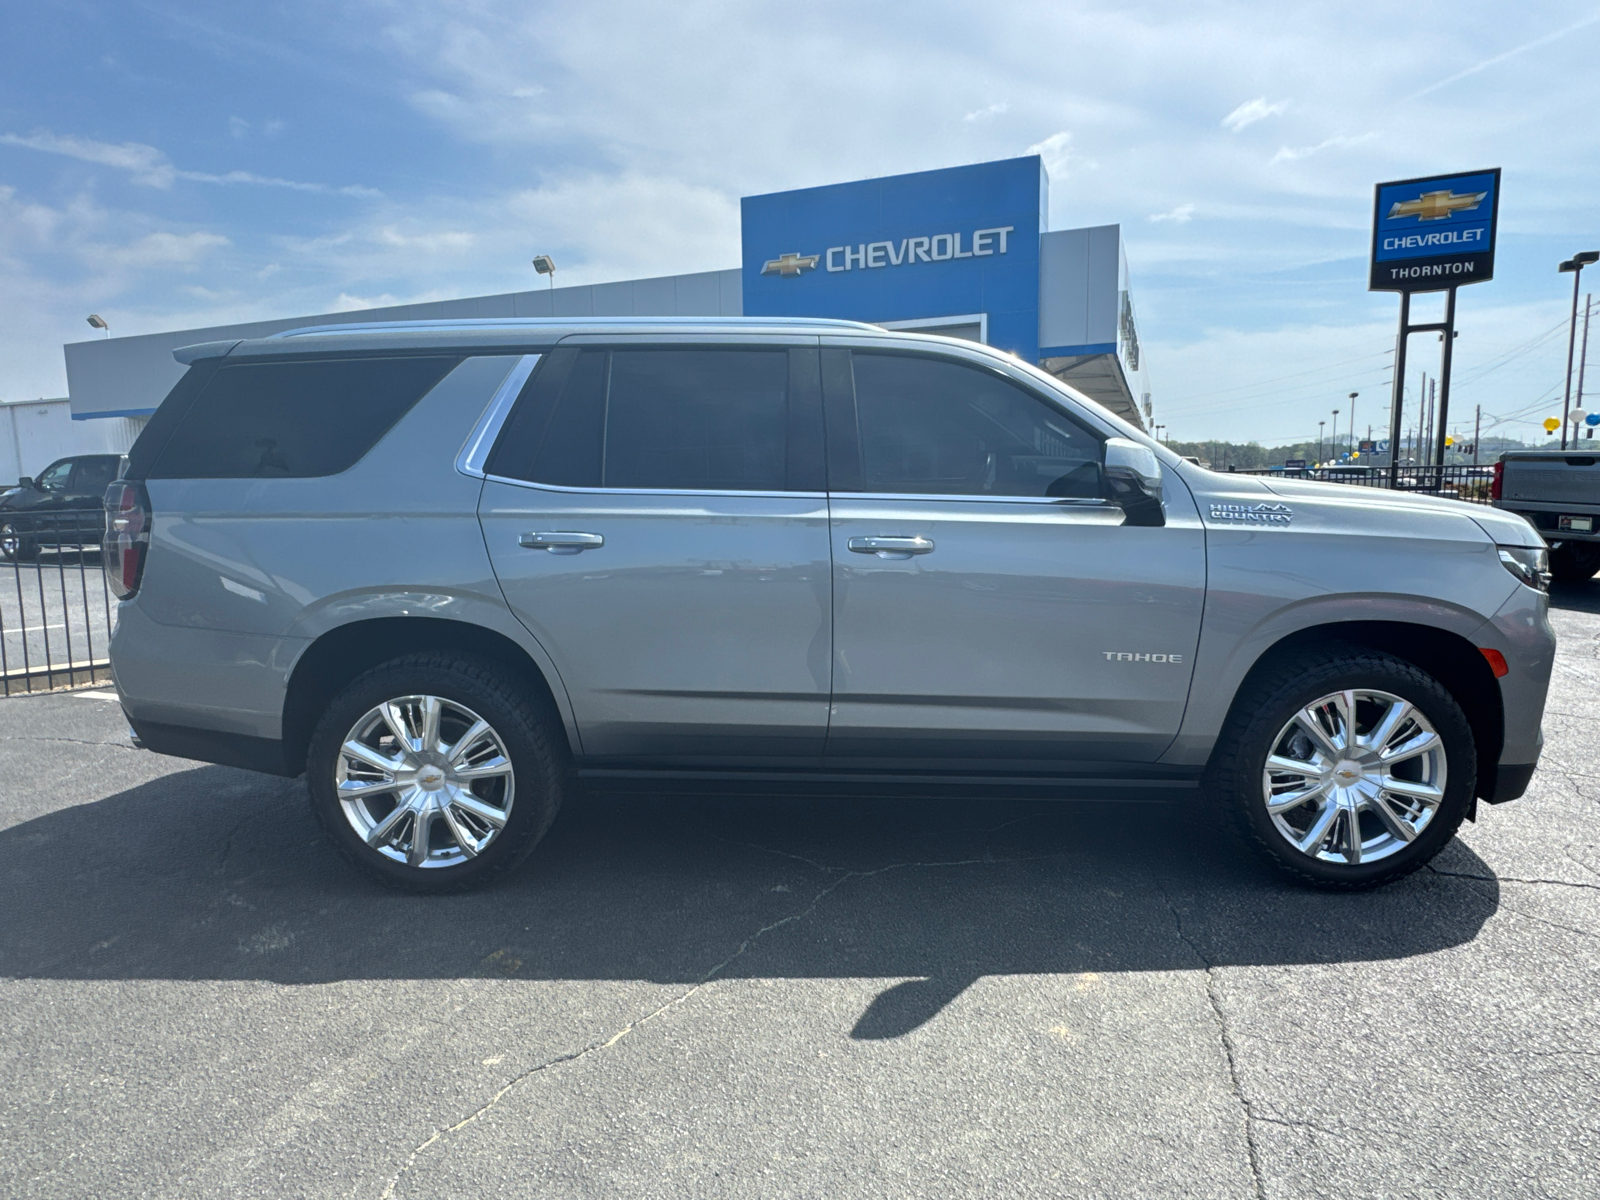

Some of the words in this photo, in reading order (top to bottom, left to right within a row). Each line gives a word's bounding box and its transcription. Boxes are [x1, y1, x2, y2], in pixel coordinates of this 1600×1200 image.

[1383, 228, 1484, 250] CHEVROLET
[826, 226, 1014, 272] CHEVROLET
[1390, 261, 1475, 279] THORNTON
[1209, 503, 1253, 512] HIGH
[1210, 511, 1294, 522] COUNTRY
[1102, 651, 1183, 664] TAHOE
